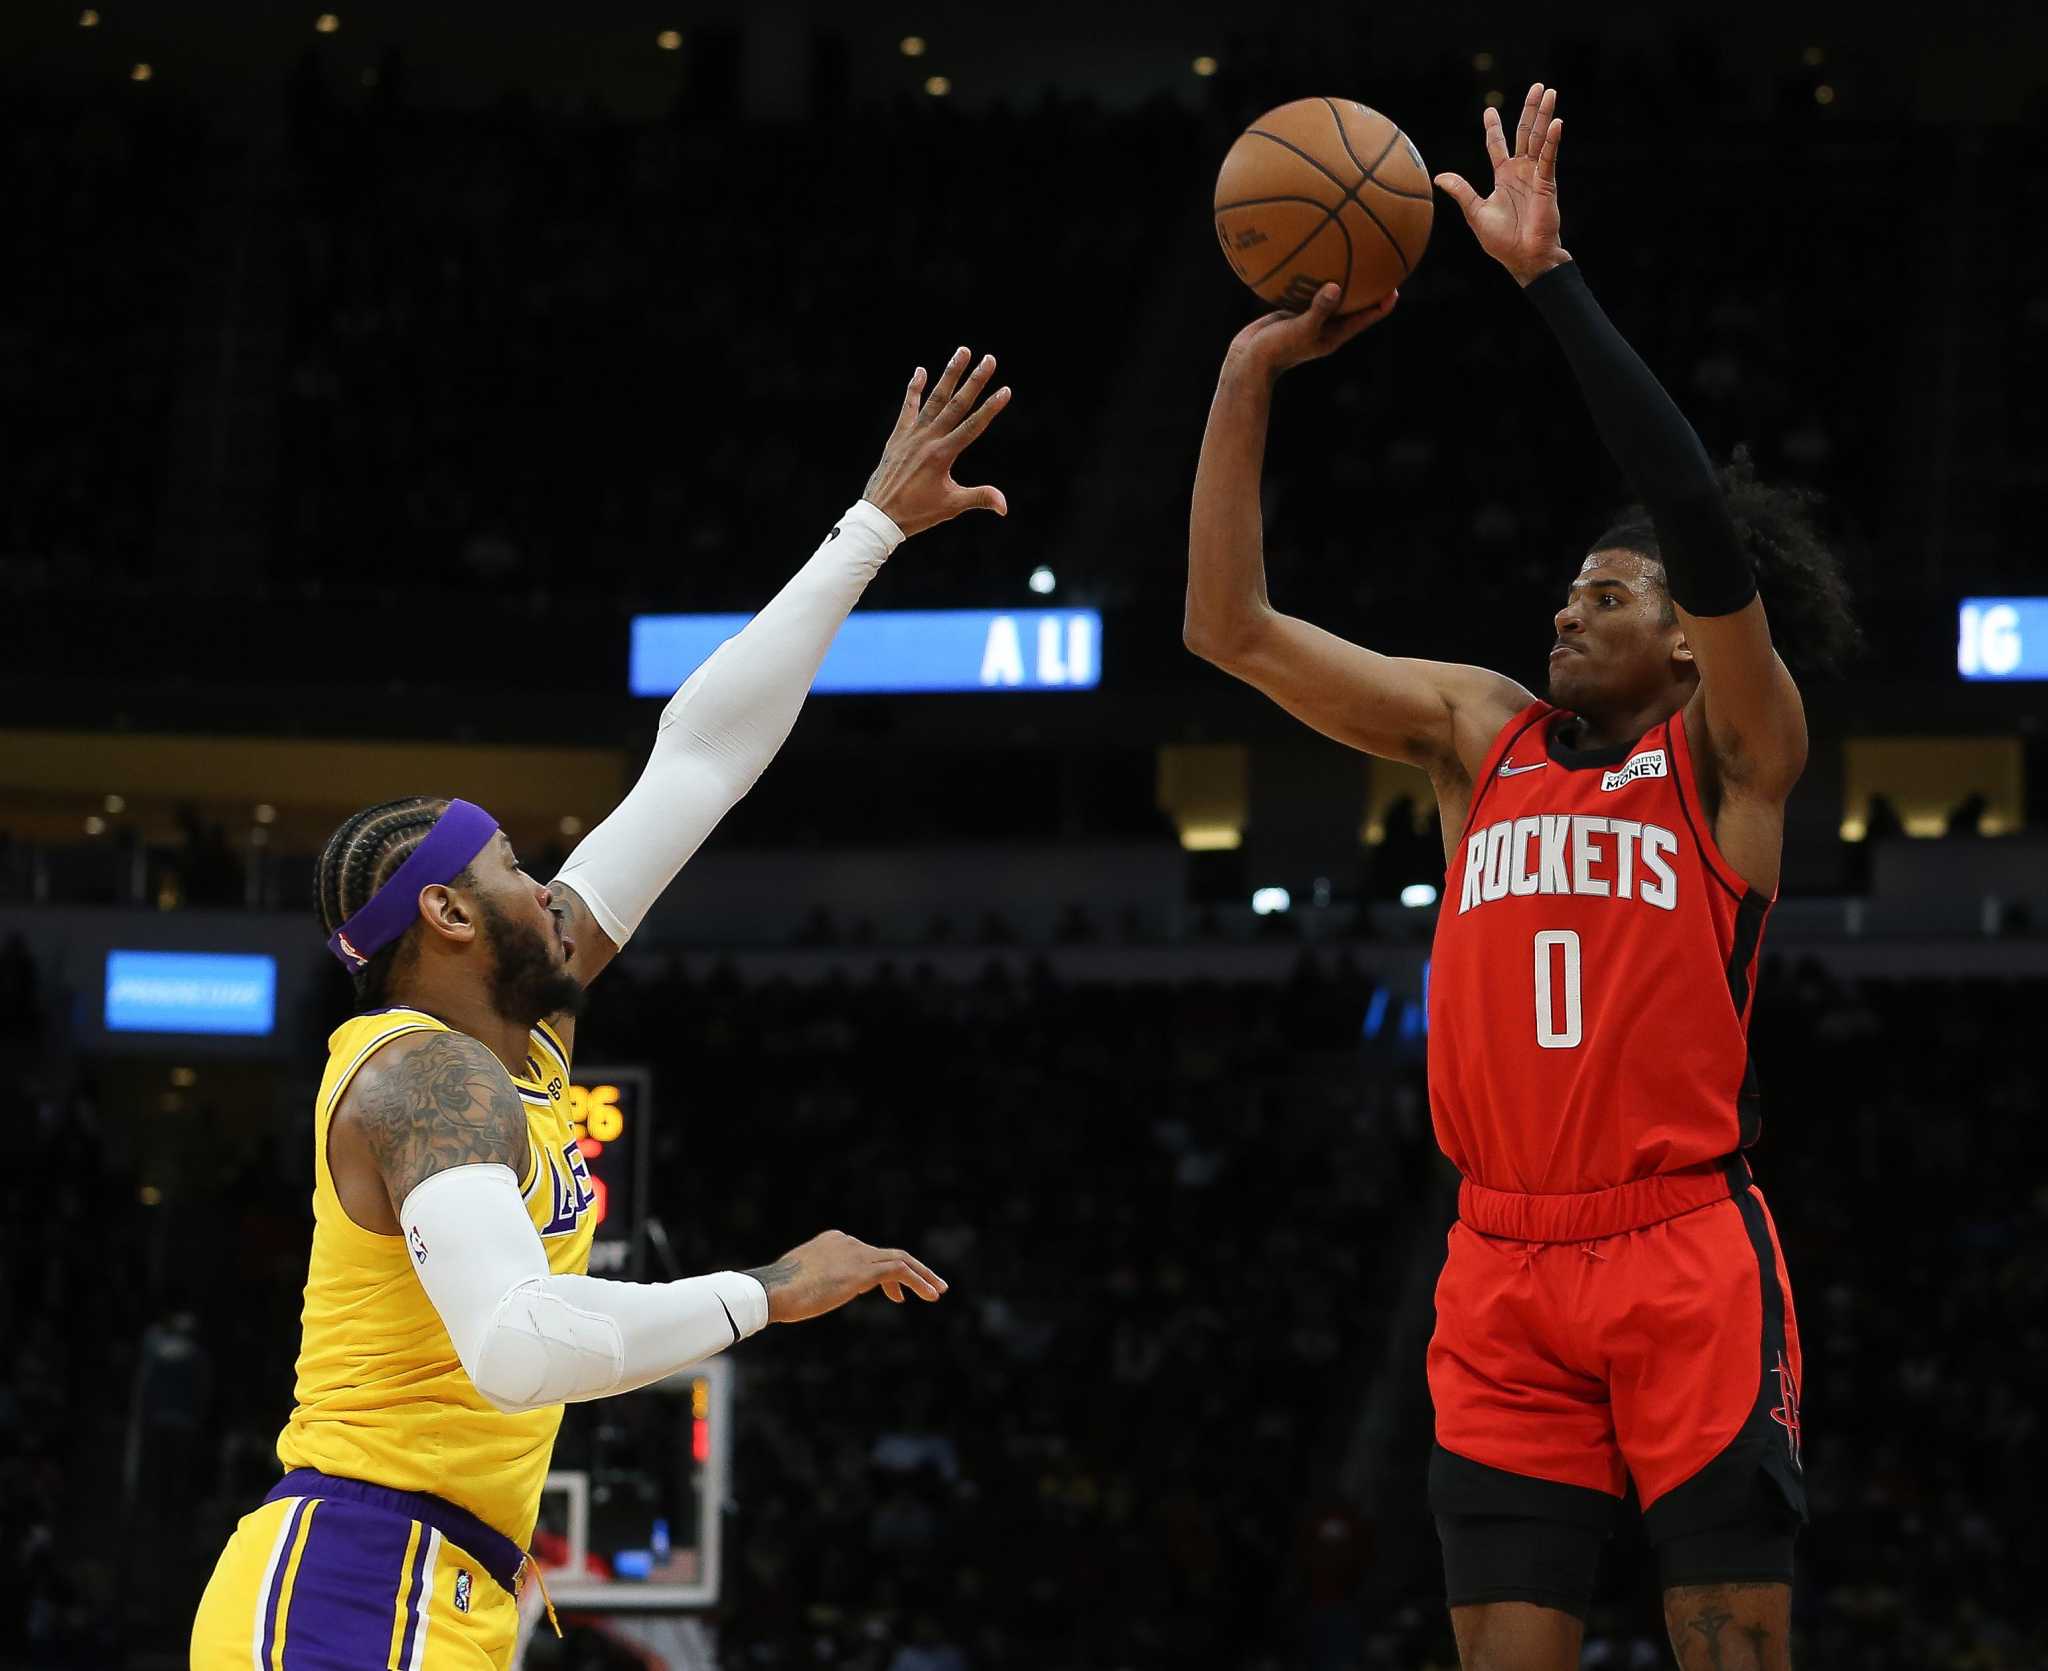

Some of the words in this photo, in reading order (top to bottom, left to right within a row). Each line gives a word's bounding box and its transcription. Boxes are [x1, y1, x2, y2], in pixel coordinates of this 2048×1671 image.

[980, 615, 1023, 686] A
[1037, 614, 1091, 685] LI
[1606, 763, 1661, 790] MONEY
[1458, 814, 1678, 916] ROCKETS
[1534, 930, 1582, 1048] 0
